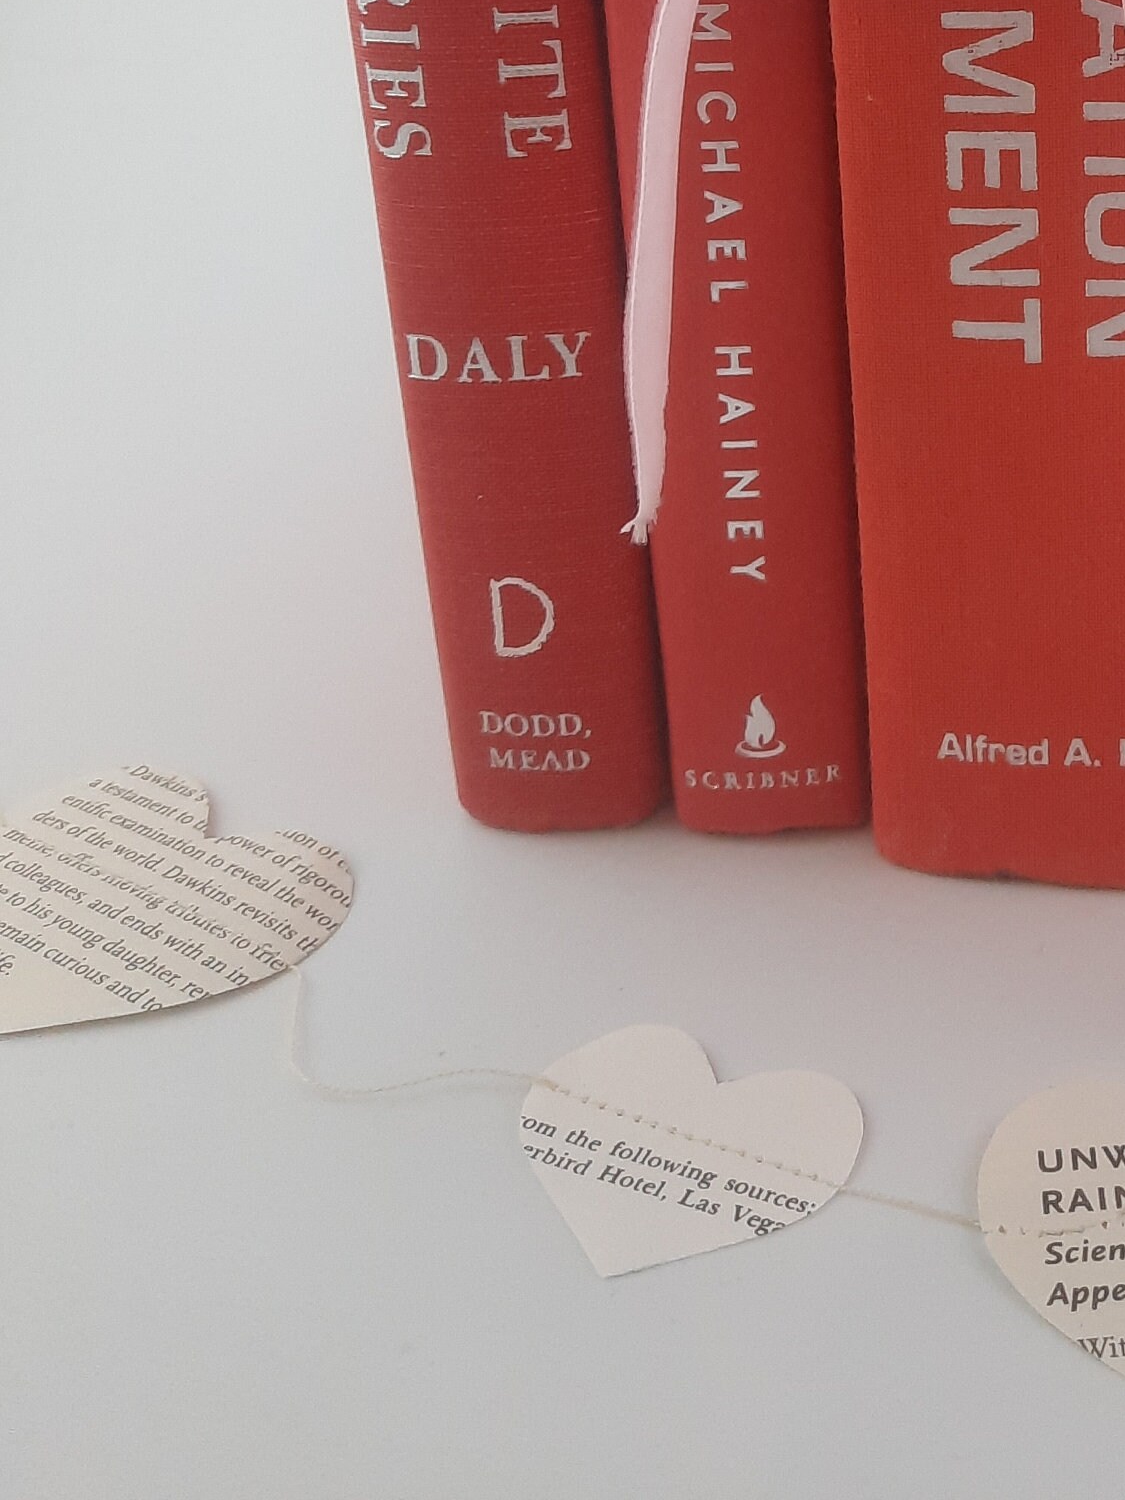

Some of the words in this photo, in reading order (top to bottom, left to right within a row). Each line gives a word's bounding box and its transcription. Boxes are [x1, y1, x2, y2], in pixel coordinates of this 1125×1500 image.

[692, 3, 748, 303] MICHAEL
[404, 331, 591, 383] DALY
[714, 345, 766, 582] HAINEY
[490, 577, 554, 657] D
[480, 710, 592, 739] DODD,
[937, 733, 1049, 768] Alfred
[1064, 739, 1101, 768] A.
[489, 747, 591, 772] MEAD
[685, 764, 841, 790] SCRIBNER
[89, 778, 102, 788] a
[101, 781, 178, 818] testament
[175, 811, 194, 825] to
[32, 810, 70, 831] ders
[67, 826, 97, 838] of
[84, 832, 113, 850] the
[113, 844, 165, 873] world.
[161, 865, 236, 906] Dawkins
[233, 901, 299, 940] revisits
[109, 814, 206, 860] examination
[205, 854, 224, 868] to
[224, 863, 281, 892] reveal
[273, 886, 305, 908] the
[272, 855, 302, 868] of
[3, 860, 87, 904] colleagues,
[87, 899, 129, 919] and
[120, 915, 164, 940] ends
[163, 934, 203, 961] with
[201, 955, 227, 974] an
[5, 892, 26, 906] to
[22, 898, 54, 920] his
[43, 915, 105, 949] young
[101, 939, 181, 988] daughter,
[230, 933, 250, 950] to
[43, 948, 110, 985] curious
[105, 979, 149, 1004] and
[565, 1129, 603, 1152] the
[609, 1141, 718, 1190] following
[596, 1165, 667, 1201] Hotel,
[677, 1188, 721, 1216] Las
